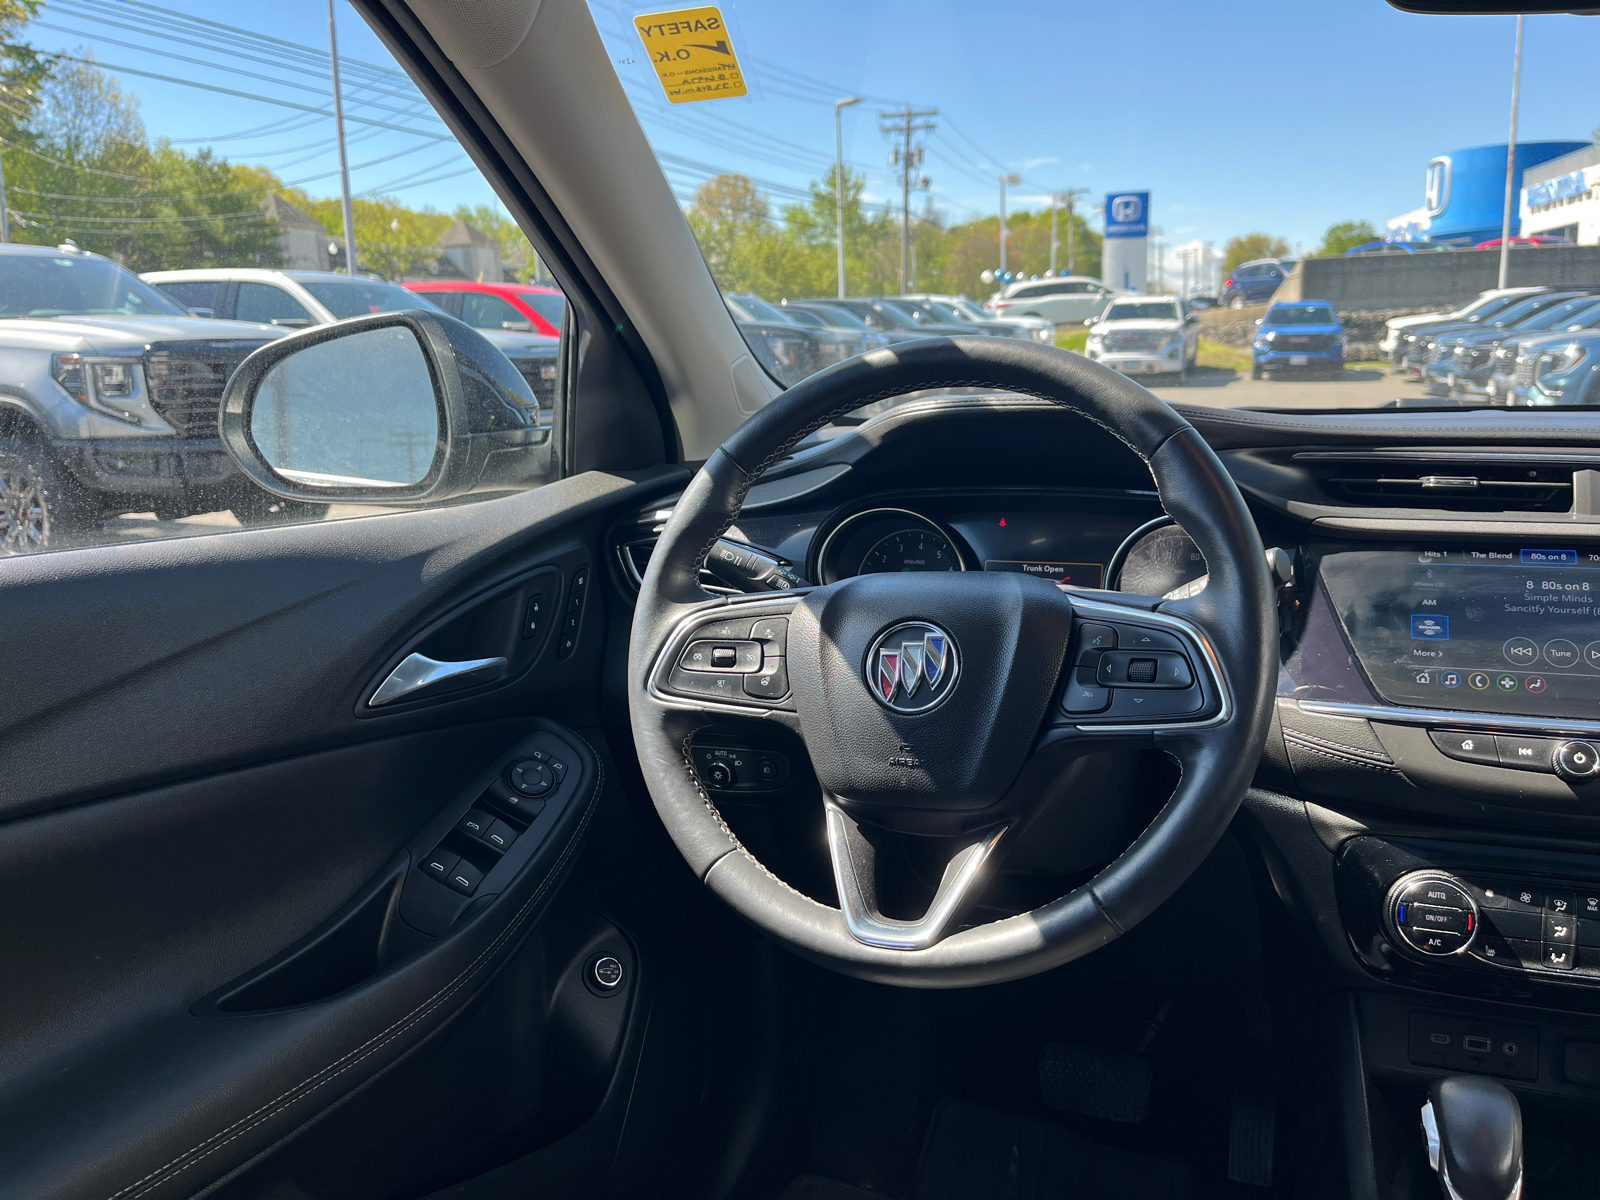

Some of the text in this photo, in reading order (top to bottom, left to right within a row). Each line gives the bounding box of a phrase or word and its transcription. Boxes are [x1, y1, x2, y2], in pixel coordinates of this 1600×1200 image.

[1424, 550, 1448, 558] Hits 1
[1471, 551, 1513, 560] The Blend
[1530, 552, 1547, 560] 80s
[1560, 553, 1567, 561] 8
[1022, 564, 1064, 574] Trunk Open
[1526, 580, 1534, 589] 8
[1541, 581, 1562, 590] 80s
[1582, 582, 1590, 591] 8
[1524, 592, 1594, 603] Simple Minds
[1504, 603, 1545, 615] Sancitfy
[1547, 605, 1591, 615] Yourself
[1413, 649, 1436, 657] More
[1550, 649, 1572, 658] Tune
[1427, 890, 1447, 899] AUTO
[1425, 914, 1448, 923] ON/OFF
[1428, 938, 1442, 947] A/C
